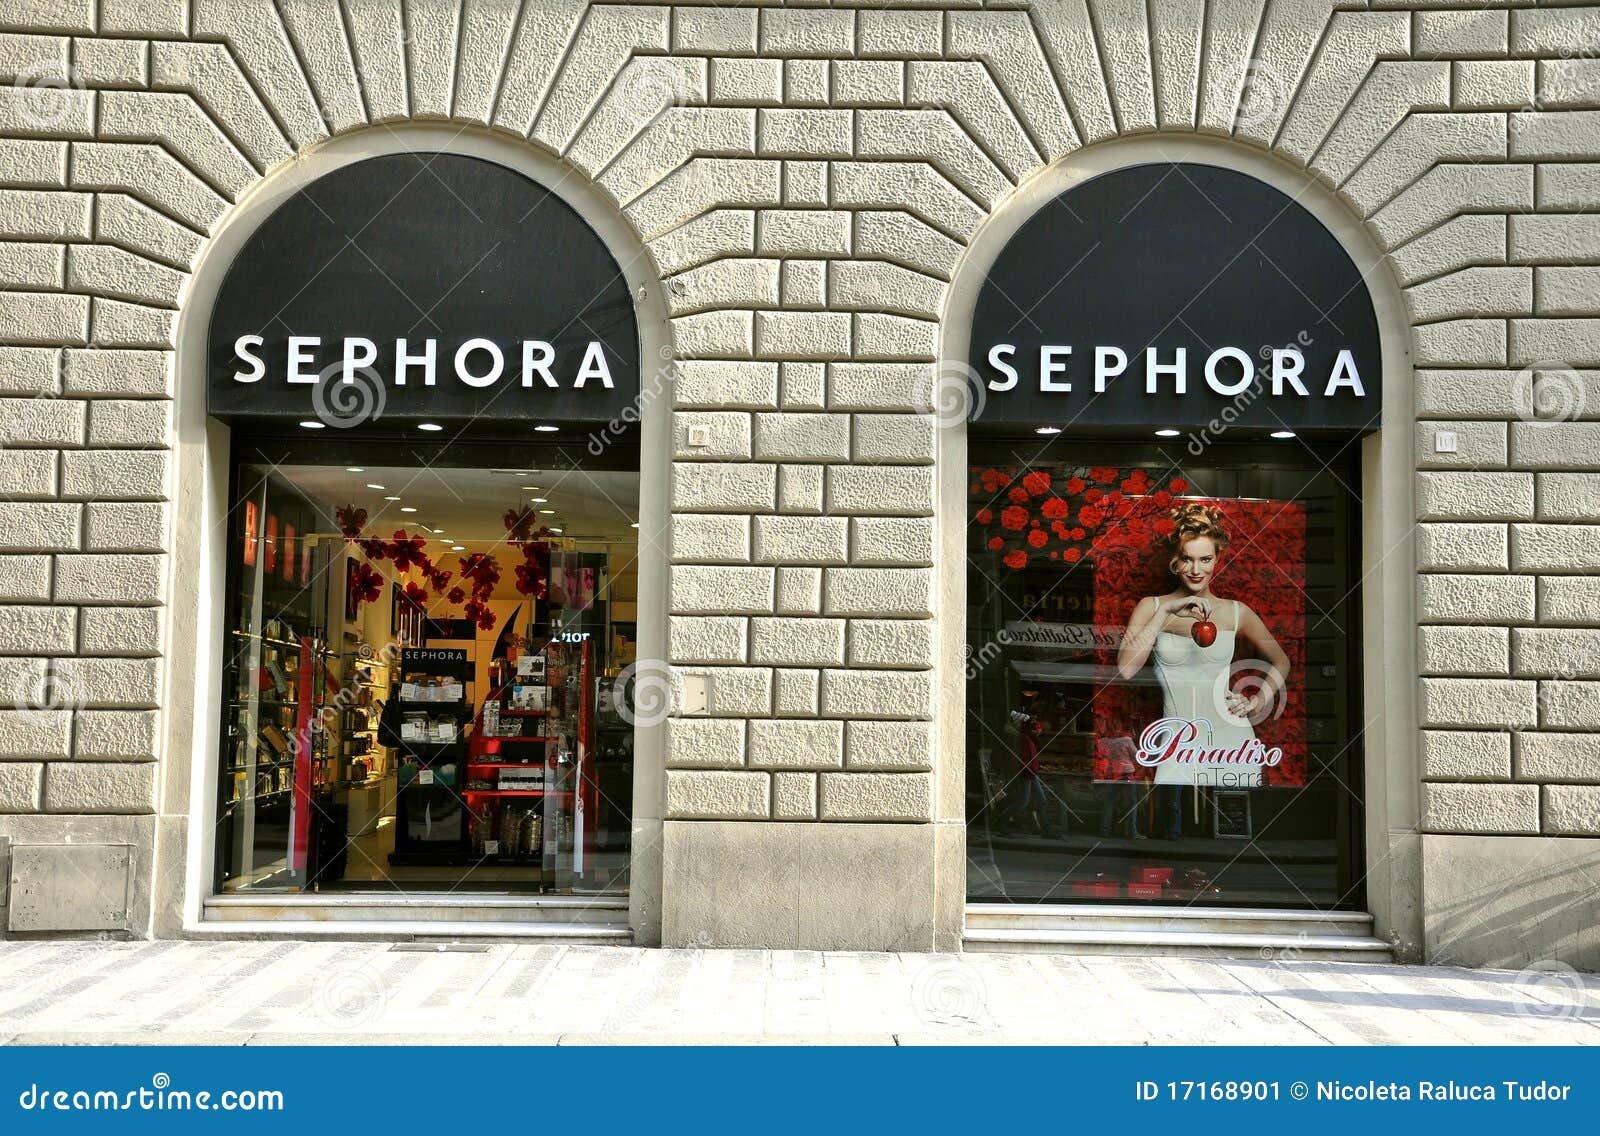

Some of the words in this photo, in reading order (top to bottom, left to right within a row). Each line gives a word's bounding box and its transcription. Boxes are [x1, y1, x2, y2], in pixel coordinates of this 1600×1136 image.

[233, 334, 614, 390] SEPHORA
[988, 344, 1366, 398] SEPHORA
[404, 650, 464, 661] SEPHORA
[1135, 717, 1282, 767] Paradiso
